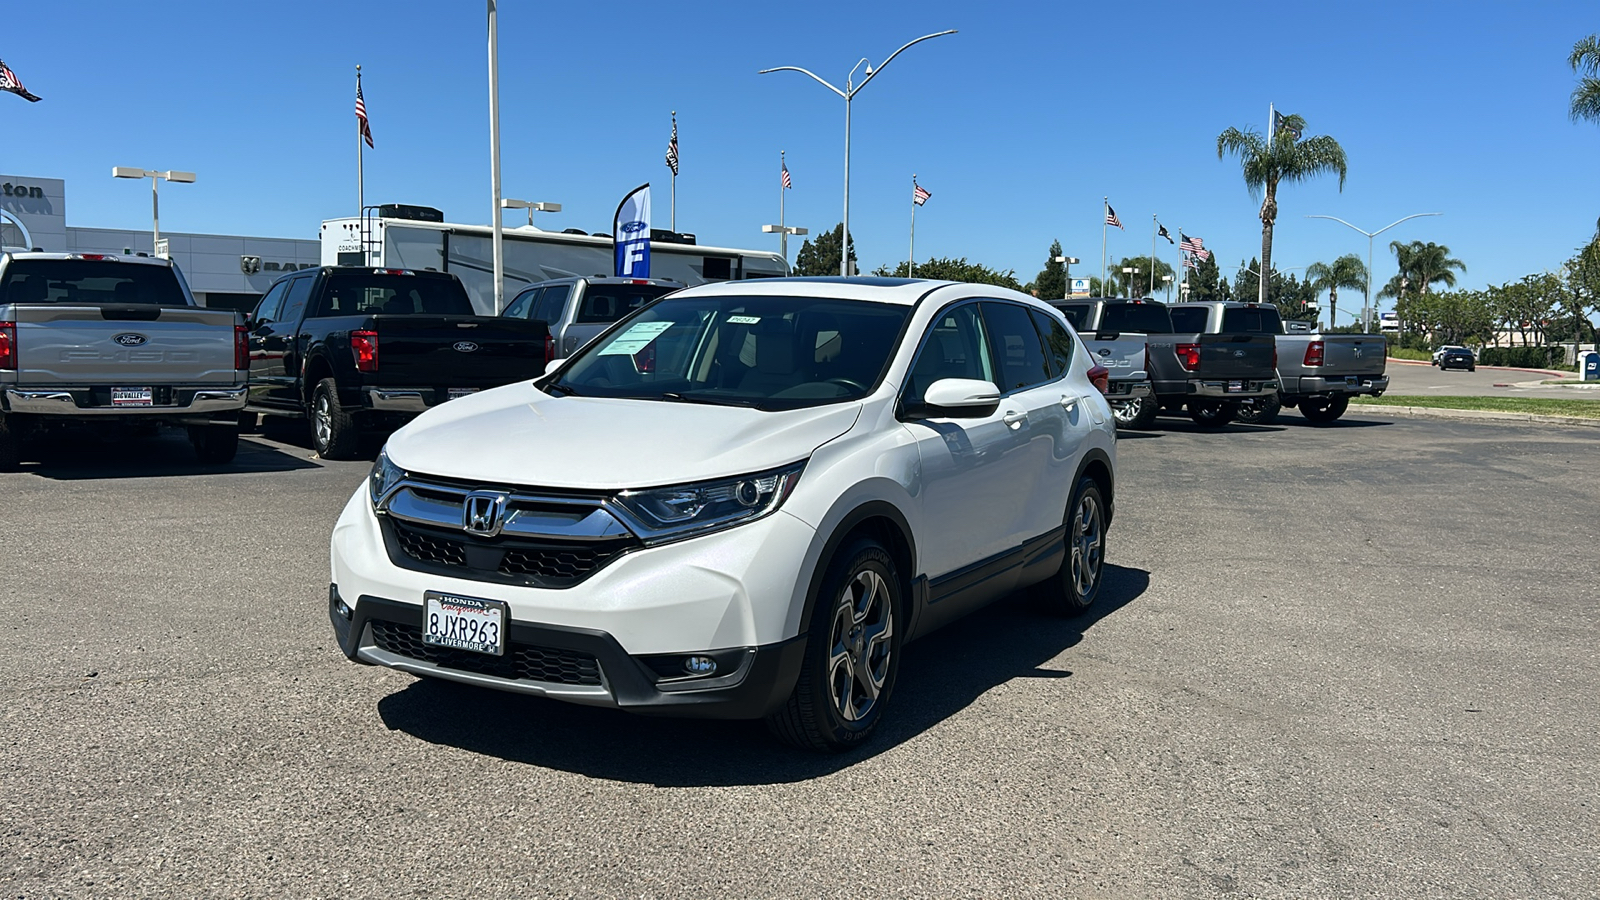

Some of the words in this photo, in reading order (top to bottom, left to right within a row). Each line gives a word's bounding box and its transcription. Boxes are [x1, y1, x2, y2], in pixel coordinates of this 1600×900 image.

[623, 242, 645, 275] F
[120, 335, 141, 344] Ford
[443, 596, 484, 608] HONDA
[429, 612, 499, 646] 8JXR963
[440, 636, 484, 651] LIVERMORE
